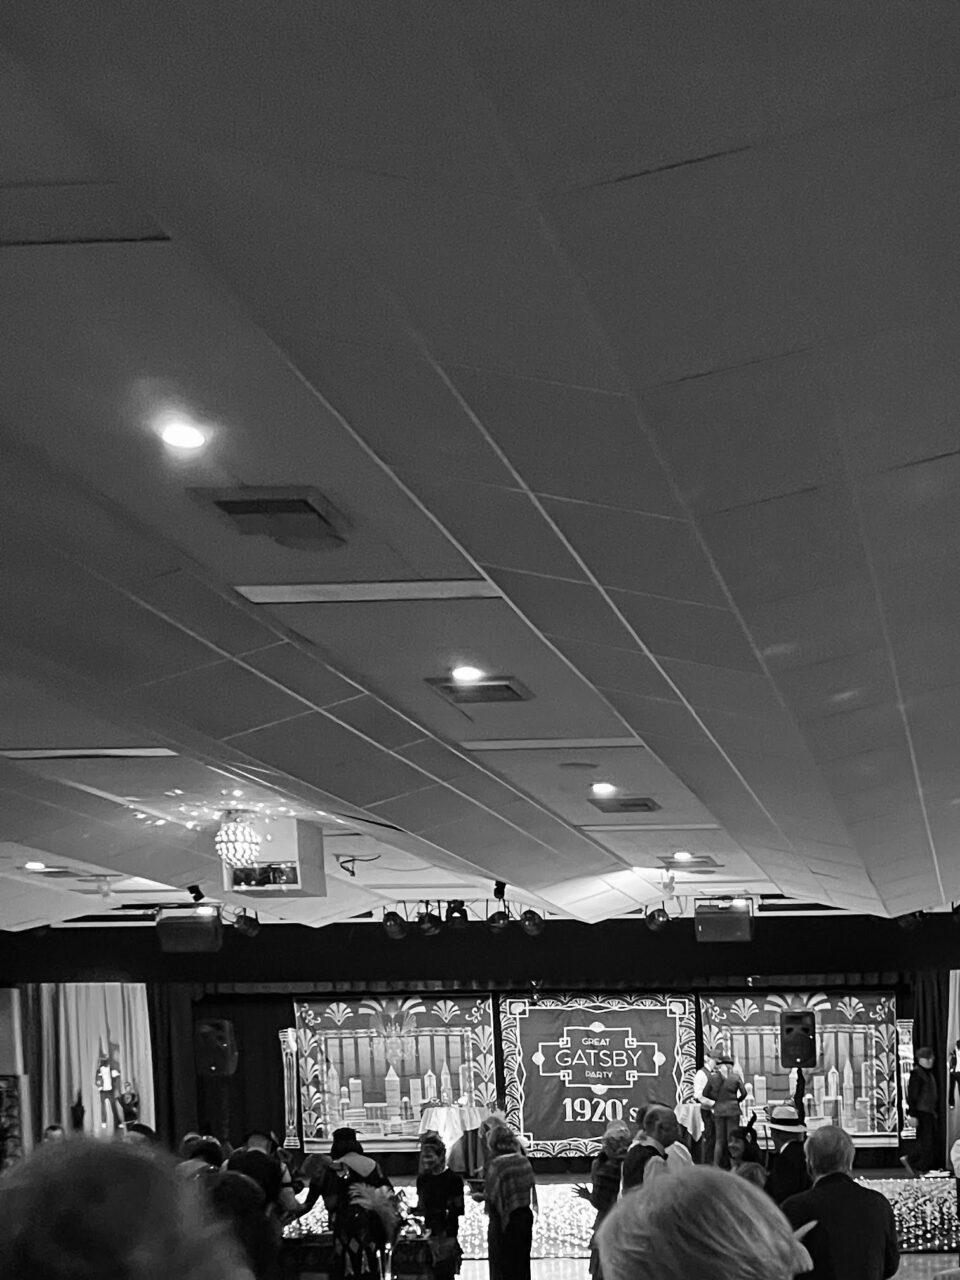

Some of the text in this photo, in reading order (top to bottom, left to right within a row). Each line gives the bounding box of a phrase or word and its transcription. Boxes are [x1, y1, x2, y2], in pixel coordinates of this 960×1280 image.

[582, 1037, 611, 1046] GREAT
[555, 1049, 642, 1067] GATSBY
[585, 1070, 613, 1078] PARTY
[562, 1097, 639, 1122] 1920's
